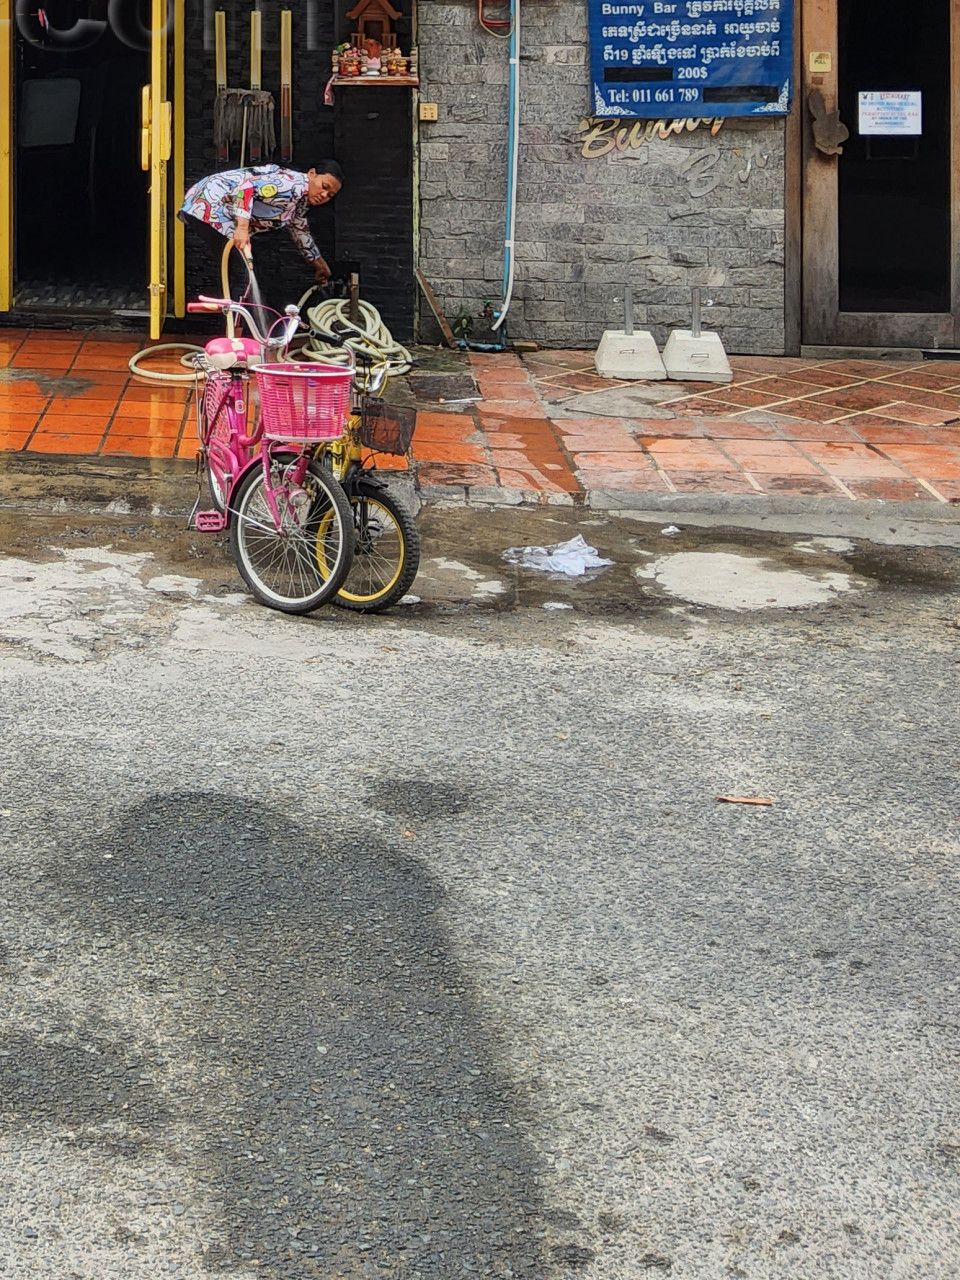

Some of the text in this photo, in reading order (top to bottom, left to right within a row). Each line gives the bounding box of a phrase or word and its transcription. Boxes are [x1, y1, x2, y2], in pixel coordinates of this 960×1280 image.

[602, 3, 644, 17] Bunny
[654, 2, 677, 14] Bar
[677, 67, 708, 80] 200$
[608, 88, 699, 103] Tel: 011 661 789
